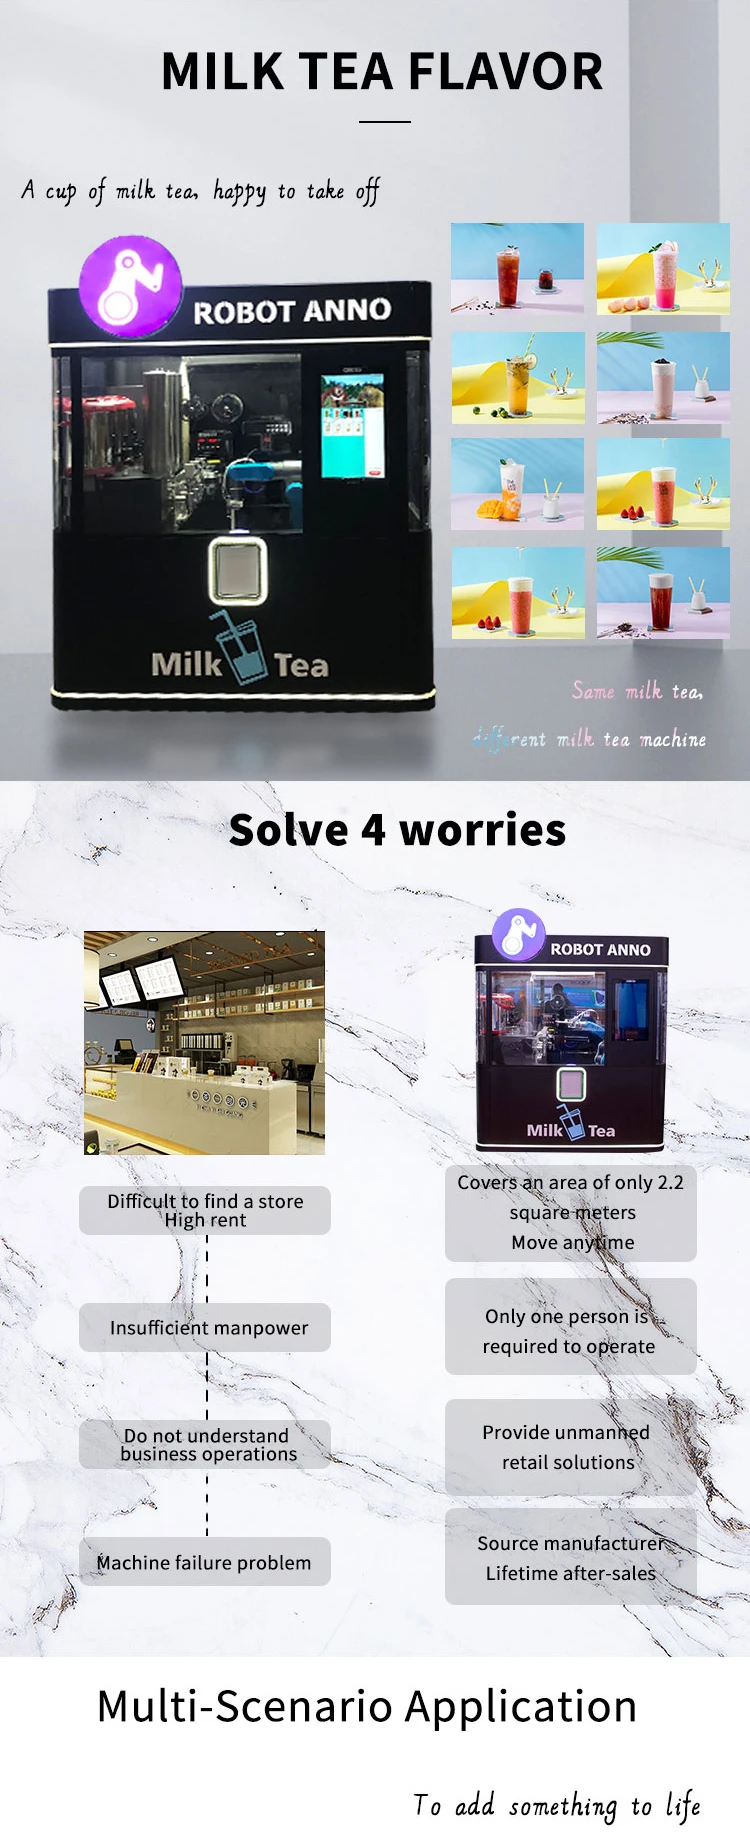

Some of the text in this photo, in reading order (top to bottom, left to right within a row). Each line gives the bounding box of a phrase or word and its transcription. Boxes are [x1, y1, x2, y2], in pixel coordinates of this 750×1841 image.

[194, 297, 392, 326] ROBOT ANNO
[151, 652, 329, 678] Milk Tea
[551, 942, 652, 958] ROBOT ANNO
[527, 1122, 616, 1139] Milk Tea
